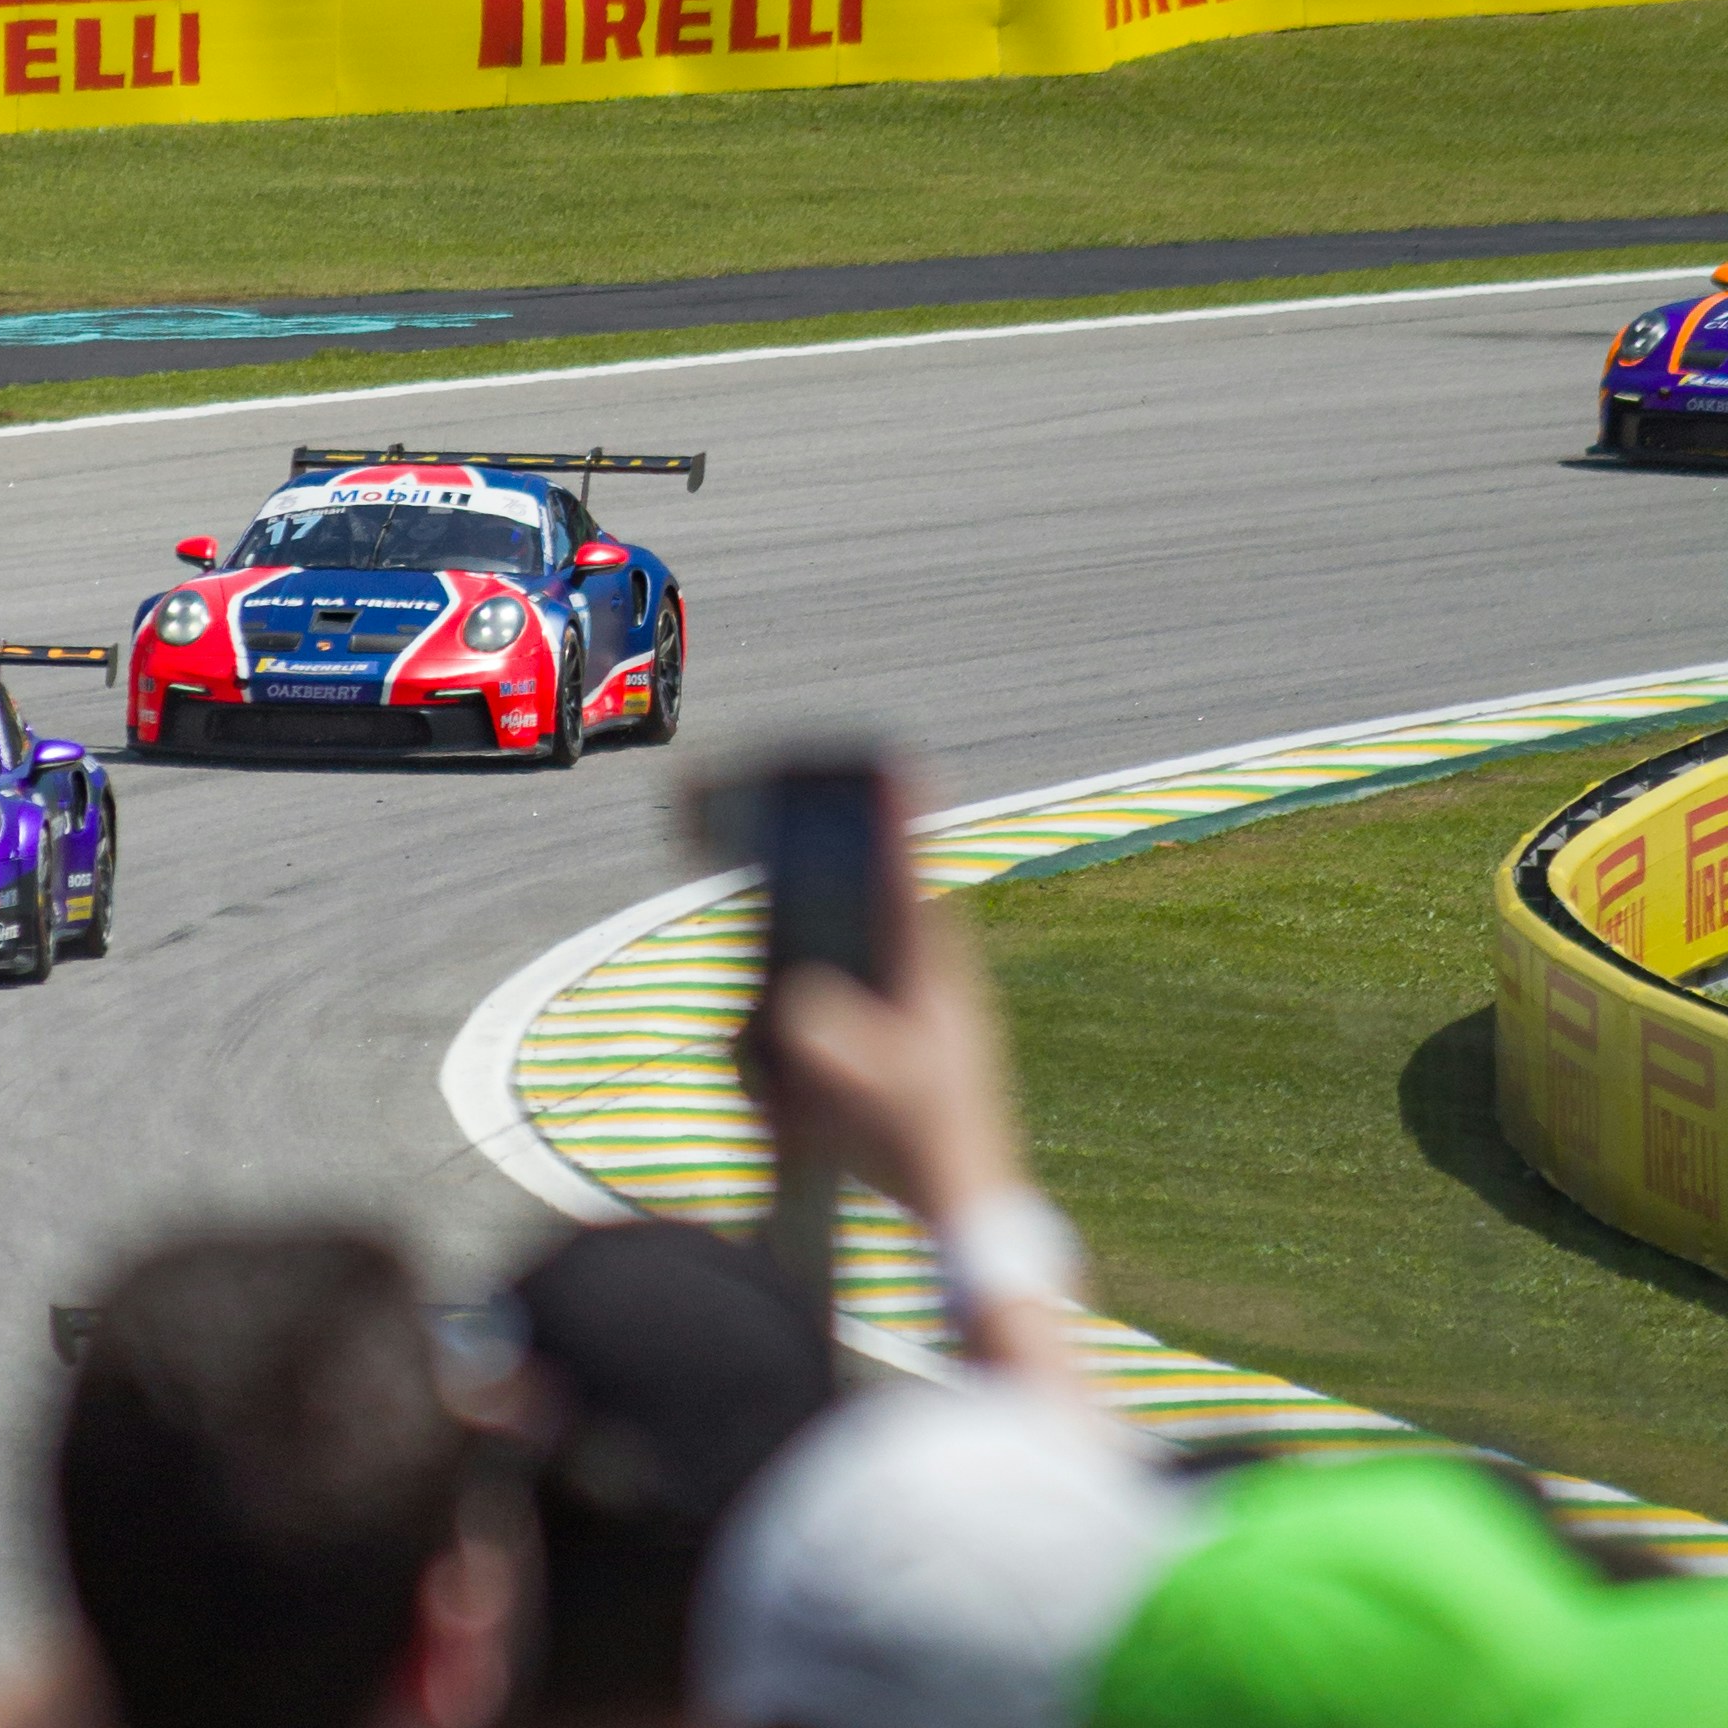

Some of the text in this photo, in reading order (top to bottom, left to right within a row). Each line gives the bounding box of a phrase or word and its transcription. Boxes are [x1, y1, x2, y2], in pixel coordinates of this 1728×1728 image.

[329, 489, 430, 504] Mobil
[265, 514, 323, 546] 17
[244, 597, 440, 611] DEUS NA FRENTE
[626, 673, 649, 686] BOSS
[267, 684, 362, 700] OAKBERRY
[68, 873, 92, 888] BOSS
